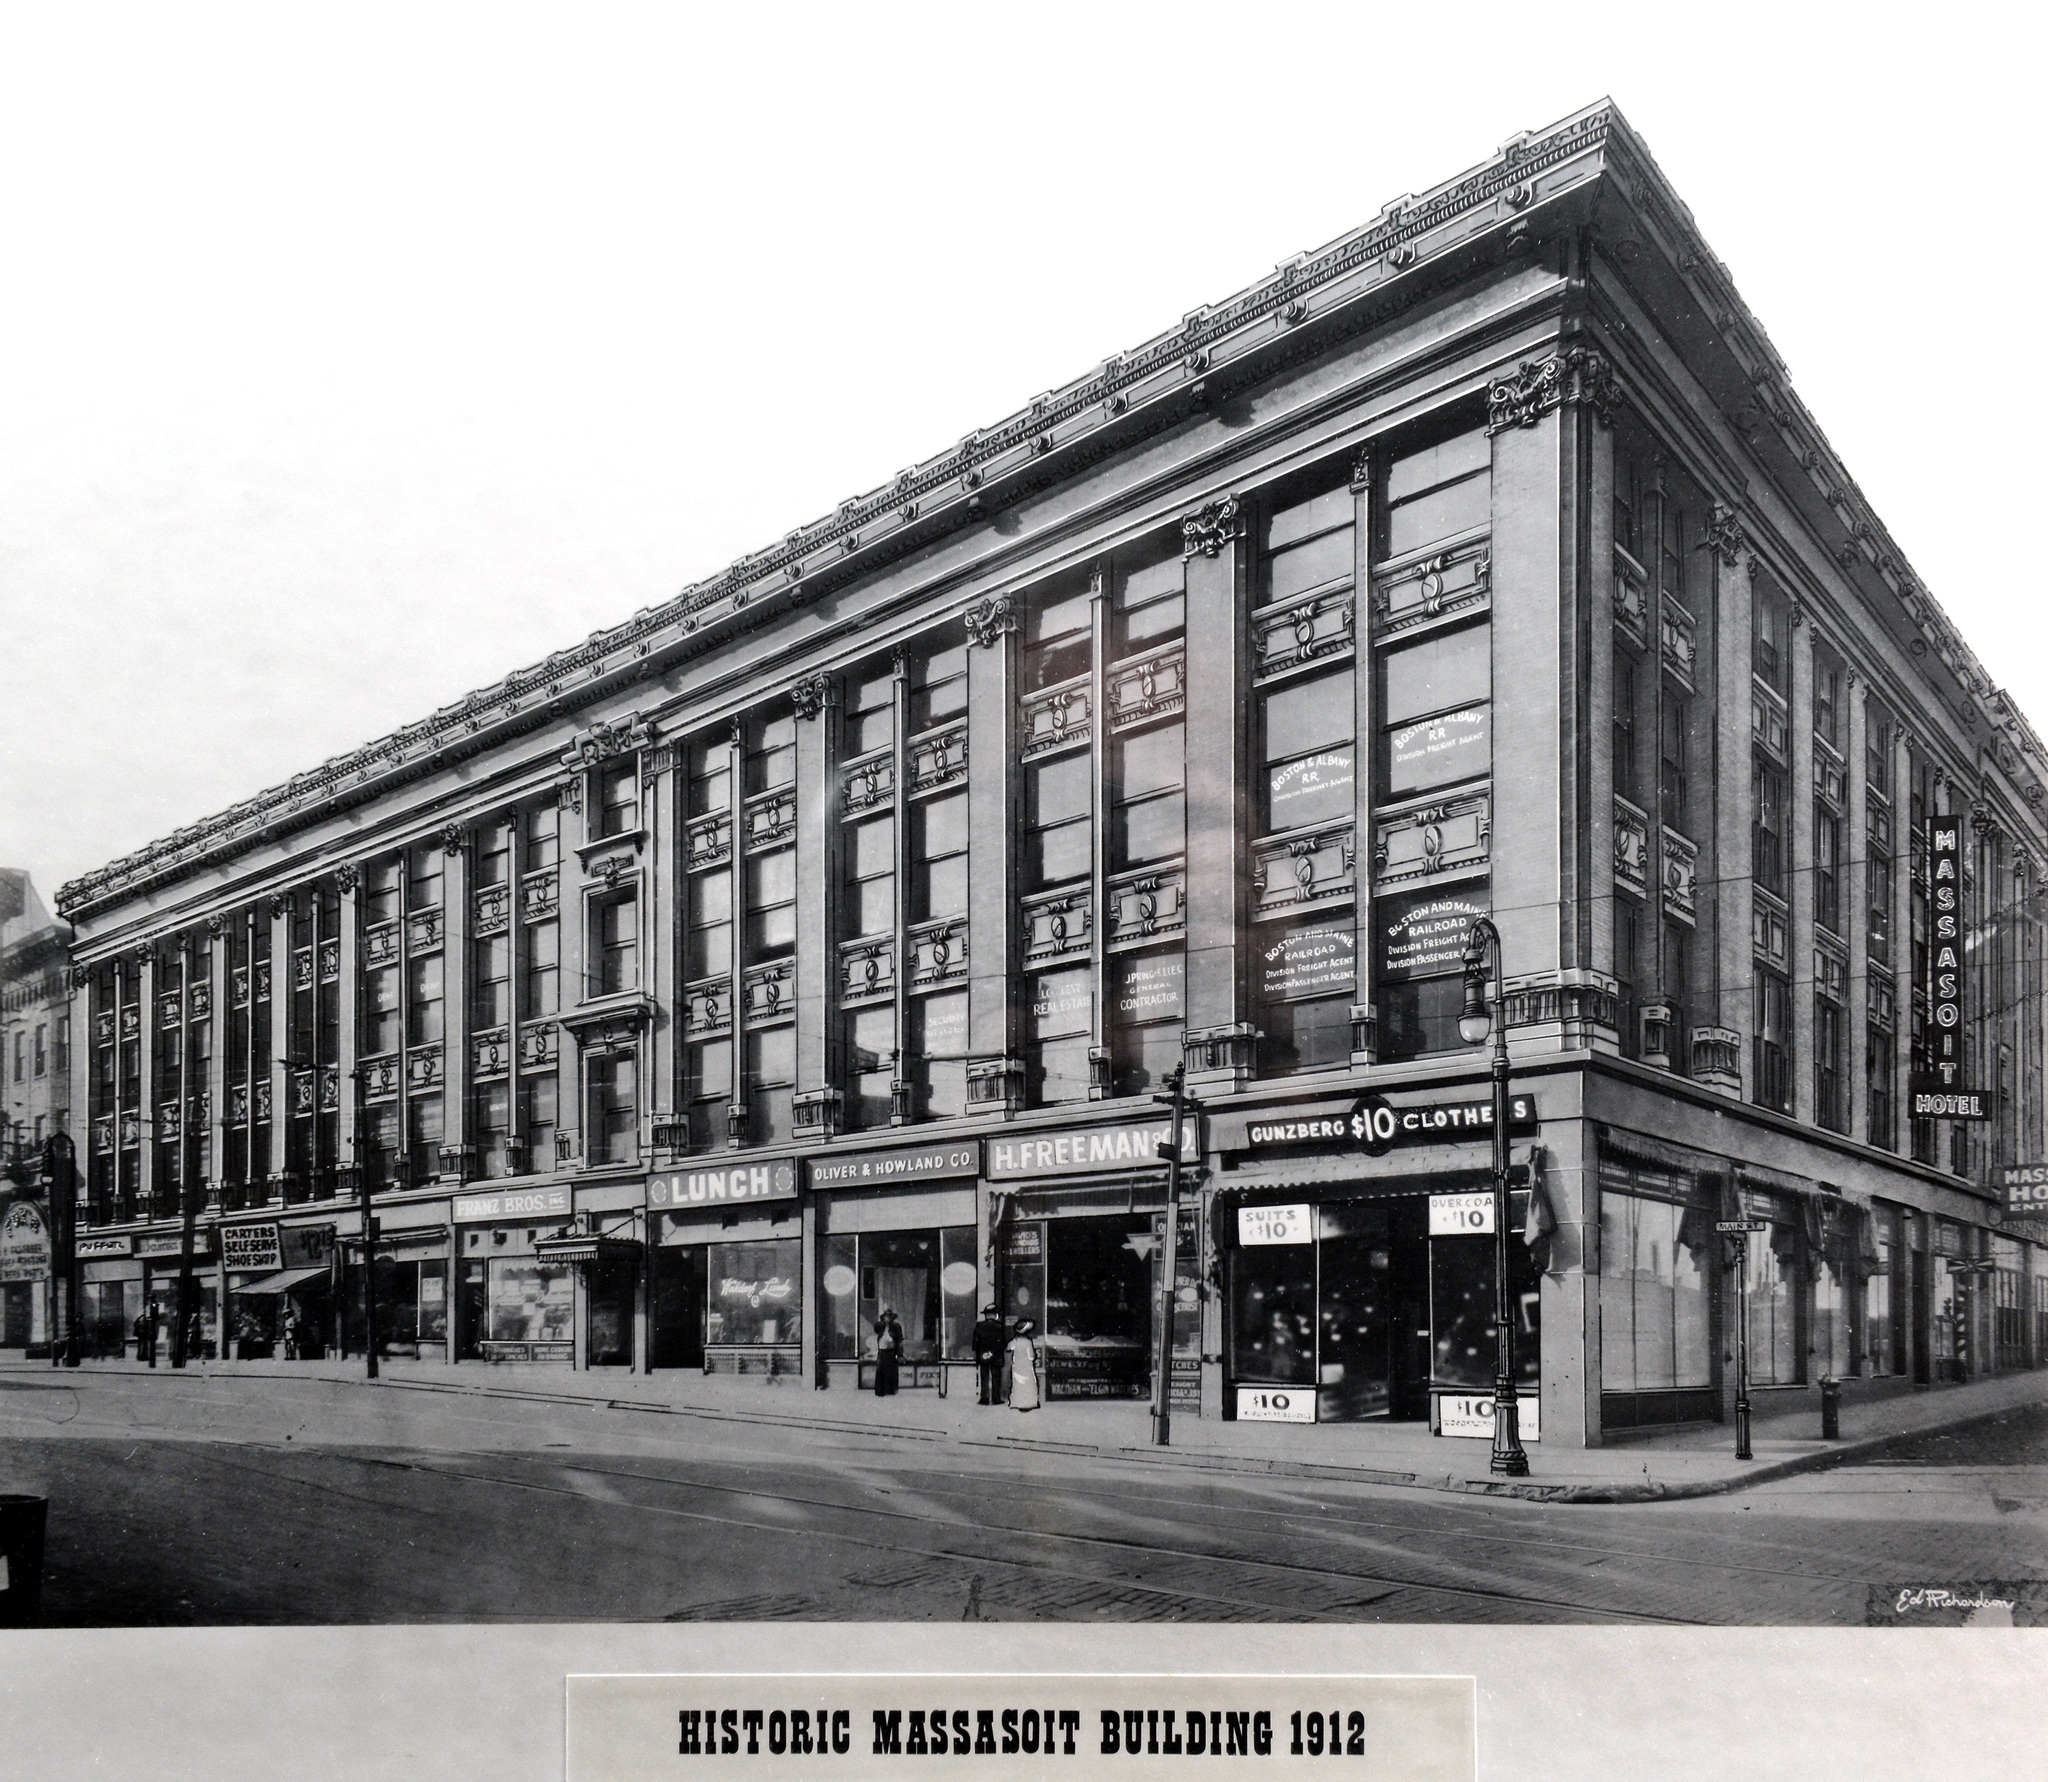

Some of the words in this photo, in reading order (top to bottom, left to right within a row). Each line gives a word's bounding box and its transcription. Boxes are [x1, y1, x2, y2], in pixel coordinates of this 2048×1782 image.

[1427, 738, 1457, 753] FREIGHT
[1459, 731, 1484, 745] AGENT
[1271, 760, 1306, 791] BOSTON
[1306, 756, 1314, 767] &
[1316, 755, 1351, 769] ALBANY
[1330, 775, 1354, 788] AGENT
[1388, 905, 1429, 937] BOSTON
[1431, 901, 1453, 914] AND
[1408, 917, 1467, 937] RAILROAD
[1265, 934, 1302, 962] BOSTON
[1284, 944, 1336, 961] RAILROAD
[1388, 943, 1422, 955] DIVISION
[1423, 935, 1457, 949] FREIGHT
[1386, 958, 1416, 970] DIVISION
[1416, 951, 1460, 965] PASSENGER
[1935, 829, 1960, 1085] MASSASOIT
[1265, 967, 1296, 979] DIVISION
[1297, 961, 1328, 973] FREIGHT
[1329, 956, 1354, 968] AGENT
[1330, 970, 1355, 981] AGENT
[1129, 982, 1172, 994] GENERAL
[1033, 1002, 1058, 1016] REAL
[1059, 996, 1091, 1012] ESTATE
[1120, 991, 1179, 1011] CONTRACTOR
[1916, 1094, 1983, 1116] HOTEL
[1251, 1120, 1345, 1142] GUNZBERG
[1351, 1107, 1395, 1142] $10
[1403, 1101, 1526, 1130] CLOTHES
[814, 1165, 857, 1181] OLIVER
[862, 1163, 871, 1177] &
[876, 1156, 944, 1175] HOWLAND
[950, 1152, 973, 1168] CO.
[671, 1166, 769, 1204] LUNCH
[456, 1198, 500, 1217] FRANZ
[504, 1195, 547, 1213] BROS.
[1431, 1198, 1493, 1209] OVERCOA
[1245, 1209, 1297, 1223] SUITS
[1452, 1210, 1485, 1228] $10
[225, 1227, 276, 1240] CARTERS
[1257, 1222, 1288, 1239] $10
[1720, 1223, 1744, 1231] MAIN
[720, 1277, 758, 1298] Waldorf
[758, 1277, 792, 1298] Lunch
[1252, 1394, 1290, 1411] $10
[1457, 1400, 1495, 1418] $10
